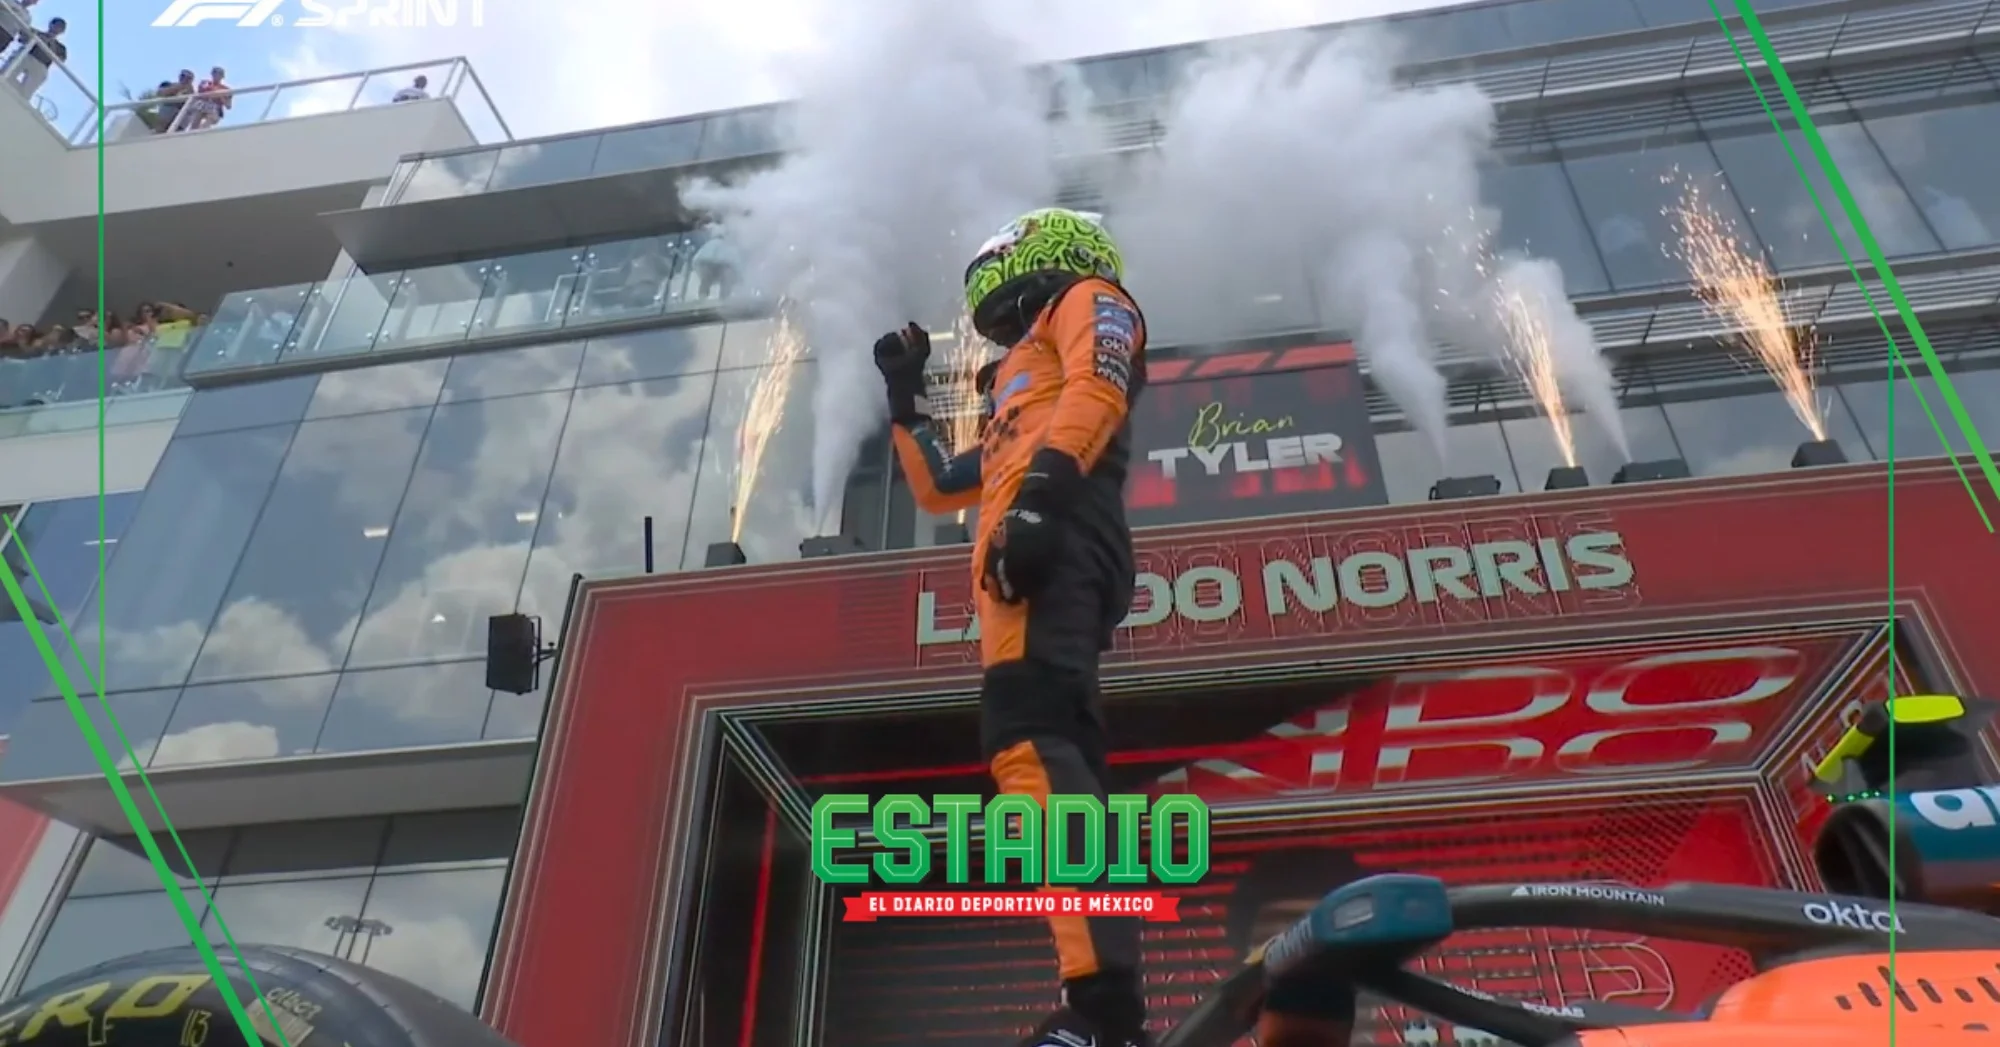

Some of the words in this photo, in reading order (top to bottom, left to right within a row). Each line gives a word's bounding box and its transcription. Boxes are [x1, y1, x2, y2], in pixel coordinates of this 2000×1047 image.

[1188, 402, 1293, 449] Brian
[1148, 432, 1344, 479] TYLER
[917, 566, 1242, 645] LDO
[1263, 532, 1634, 616] NORRIS
[1531, 885, 1571, 897] IRON
[1576, 886, 1665, 906] MOUNTAIN
[1804, 900, 1906, 934] okta
